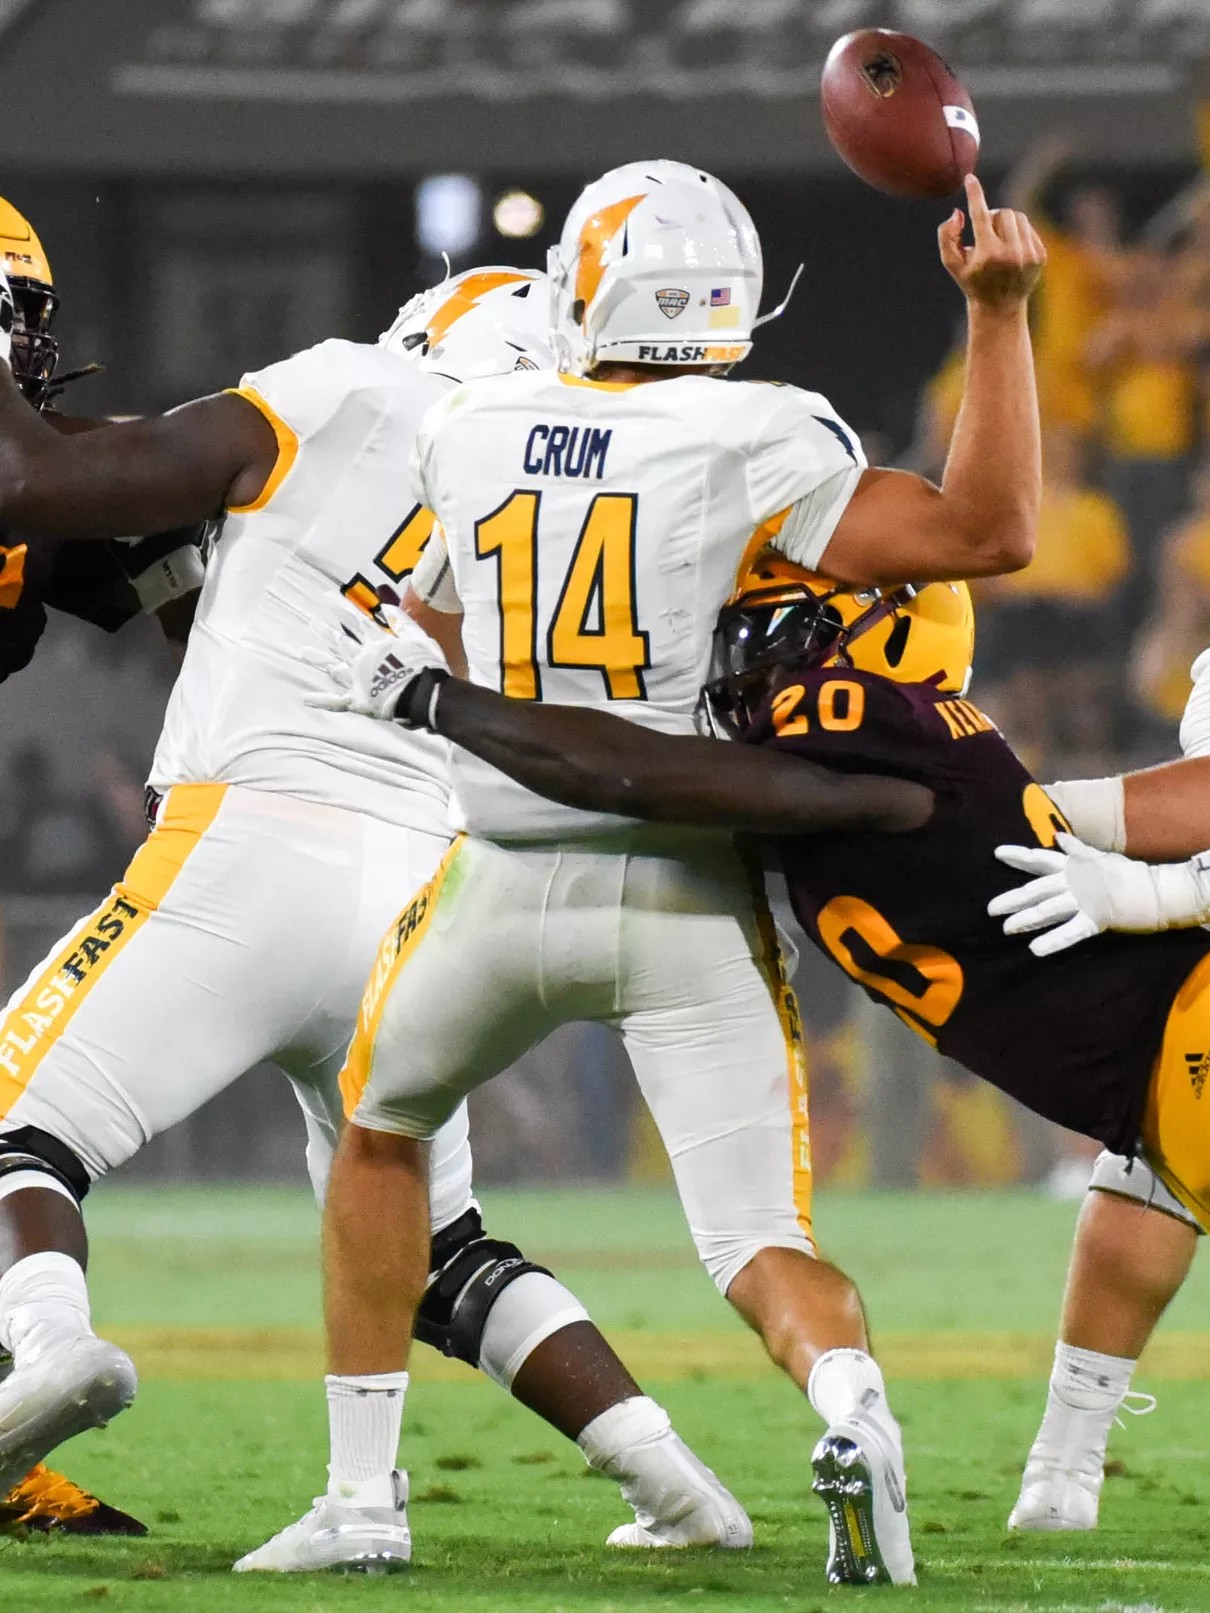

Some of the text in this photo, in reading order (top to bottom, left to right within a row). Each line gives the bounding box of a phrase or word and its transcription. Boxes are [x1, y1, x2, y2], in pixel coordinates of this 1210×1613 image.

[523, 424, 613, 479] CRUM
[474, 489, 652, 702] 14
[771, 680, 865, 737] 20
[0, 896, 139, 1077] FLASHFAST
